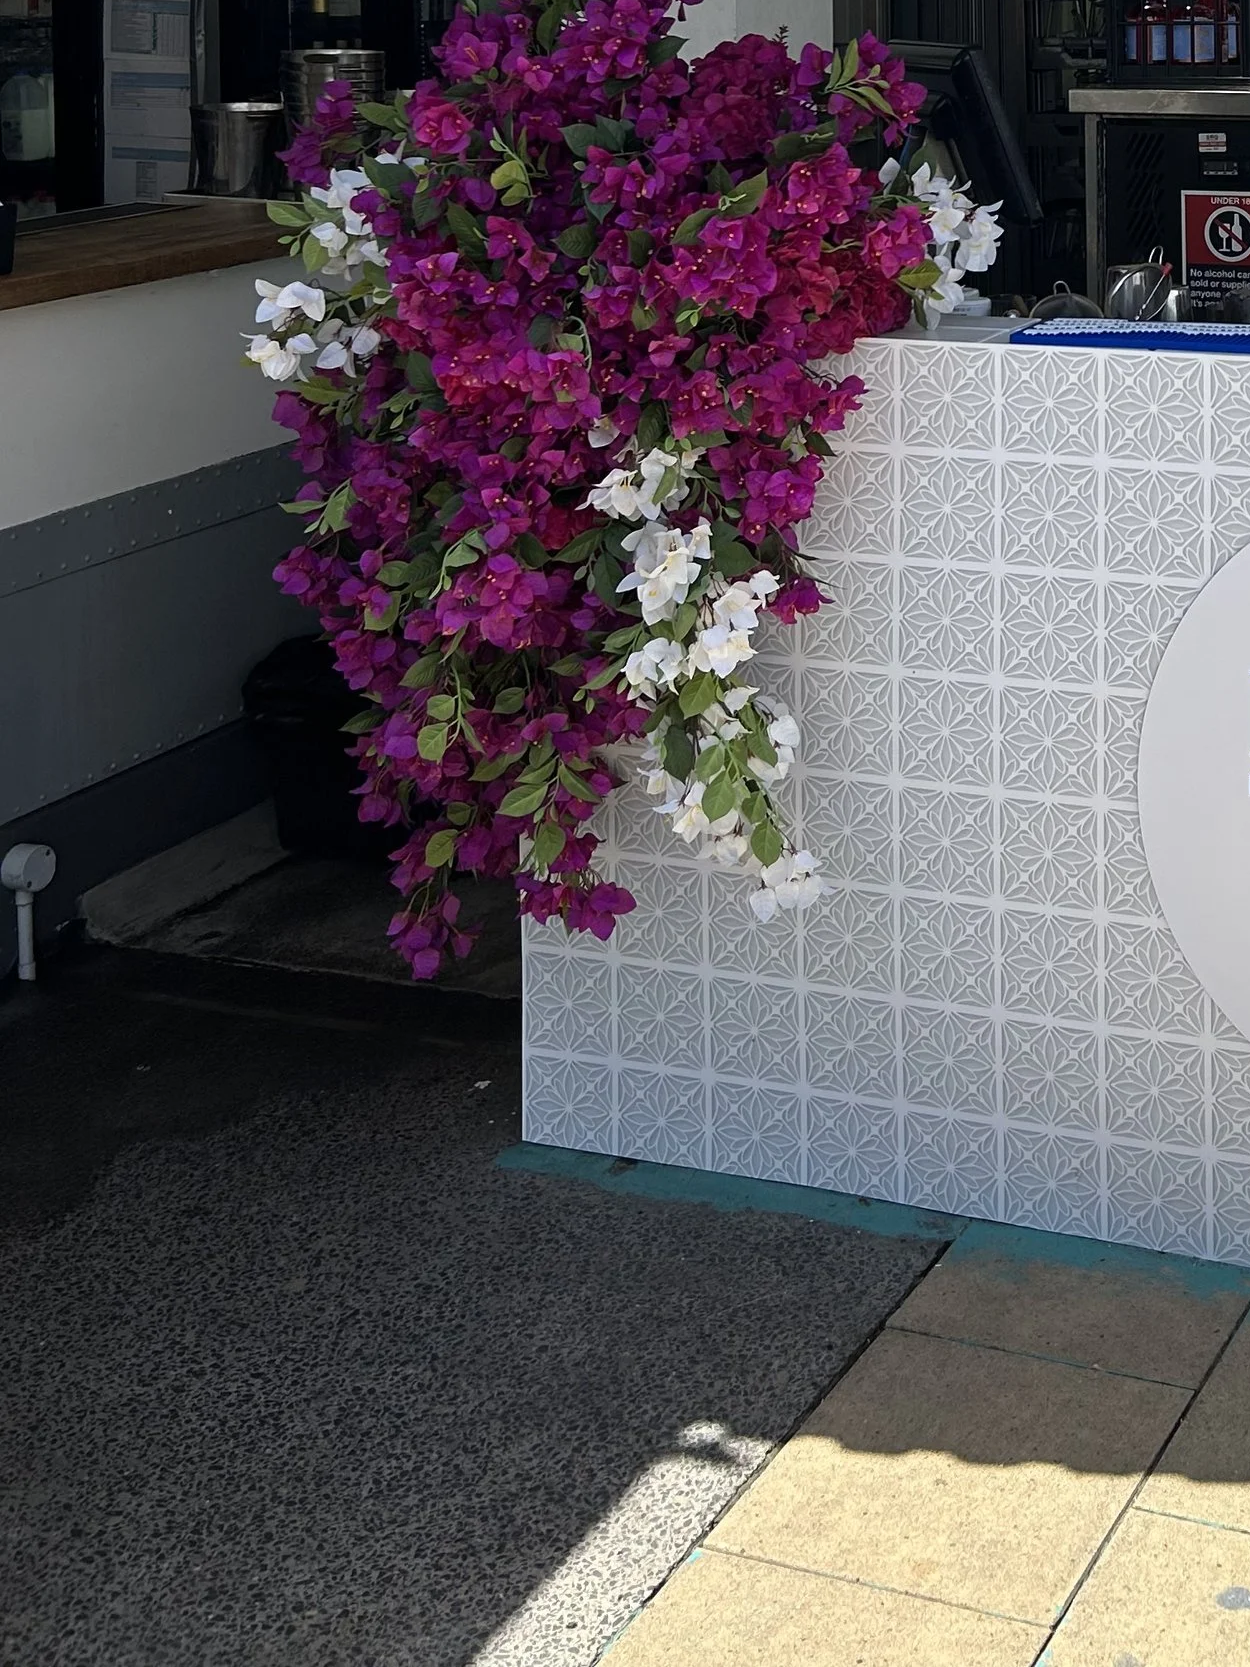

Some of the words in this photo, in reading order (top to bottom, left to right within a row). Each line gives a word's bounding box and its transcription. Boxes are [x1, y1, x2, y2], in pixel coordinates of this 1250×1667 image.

[1211, 197, 1240, 205] UNDER
[1190, 268, 1202, 277] No
[1204, 270, 1235, 278] alcohol
[1190, 279, 1208, 287] sold
[1190, 290, 1221, 298] anyone
